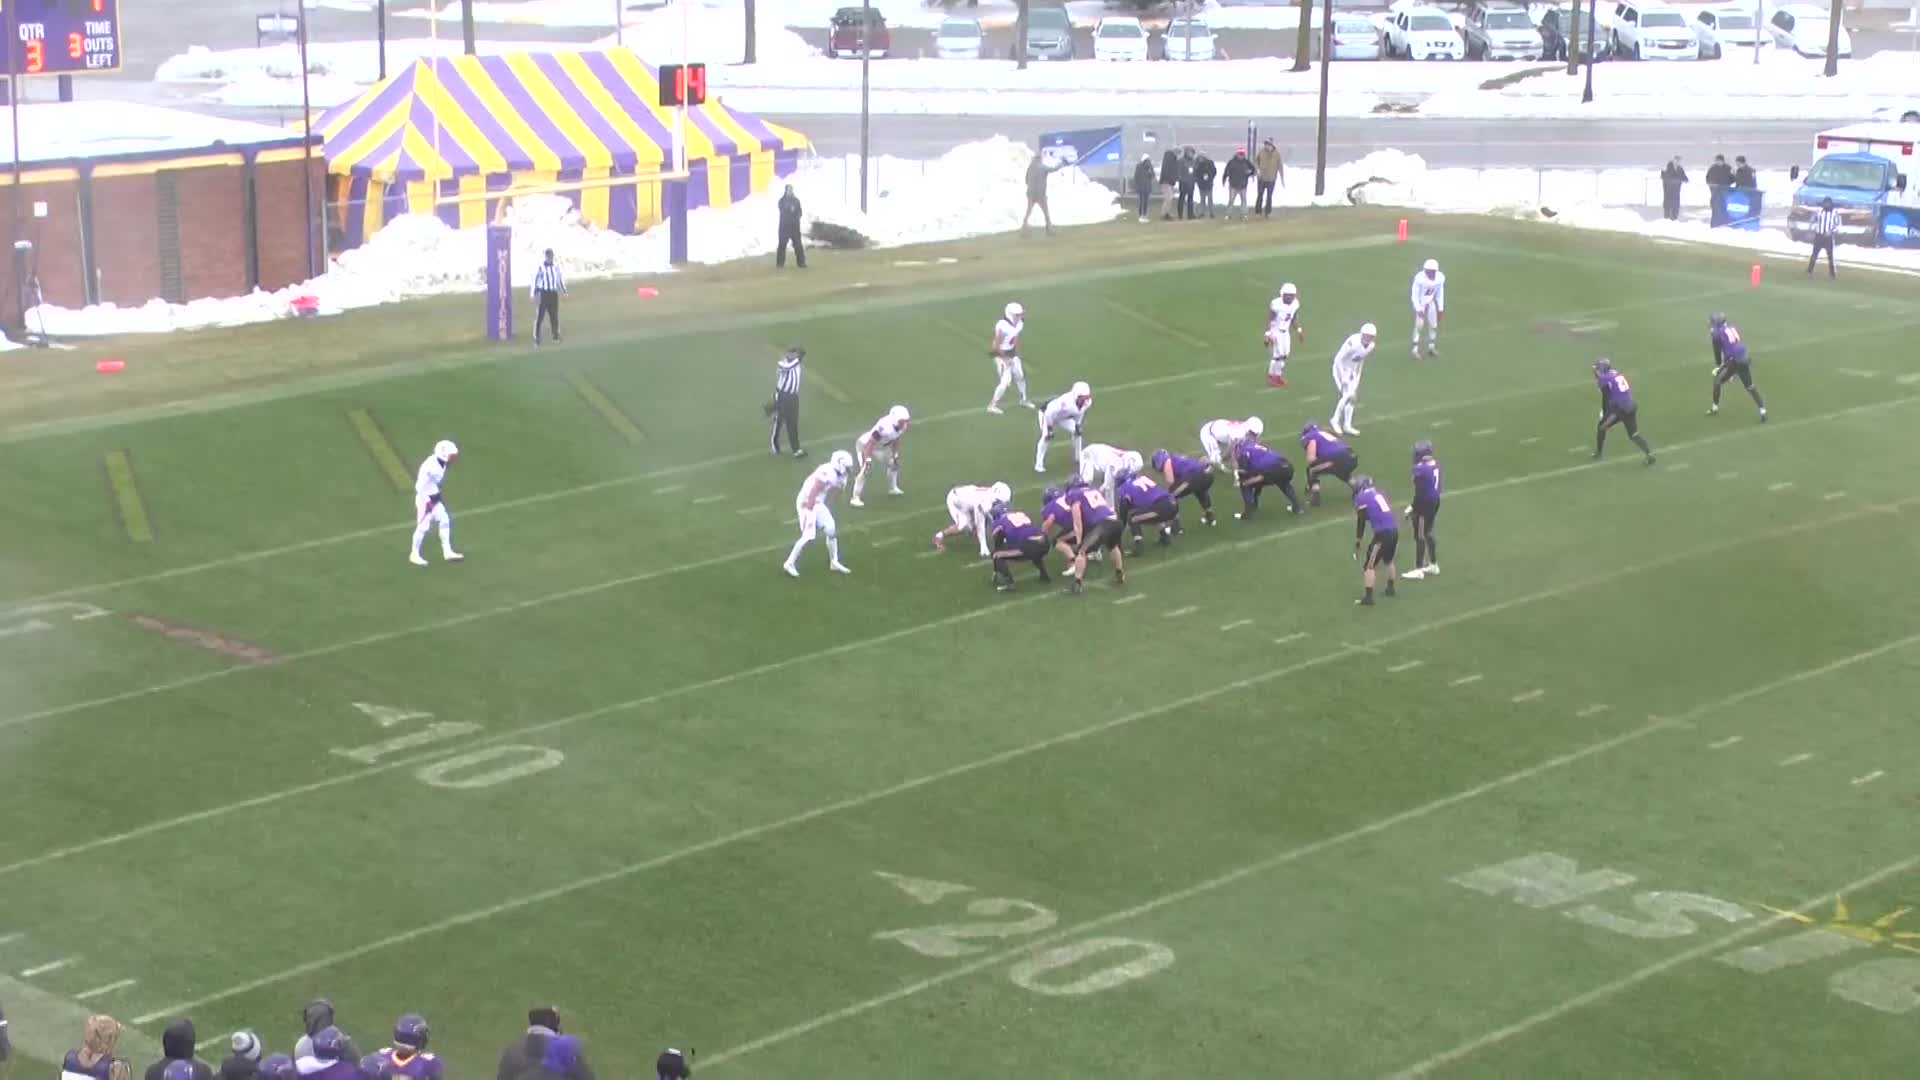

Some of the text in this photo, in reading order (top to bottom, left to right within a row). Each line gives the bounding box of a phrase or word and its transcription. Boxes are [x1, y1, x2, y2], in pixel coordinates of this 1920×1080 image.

[19, 23, 45, 40] QTR
[85, 21, 111, 34] TIME
[69, 32, 82, 58] 3
[84, 37, 114, 52] OUTS
[26, 40, 43, 72] 3
[86, 53, 113, 68] LEFT
[675, 67, 705, 100] 14
[872, 898, 1176, 996] 20
